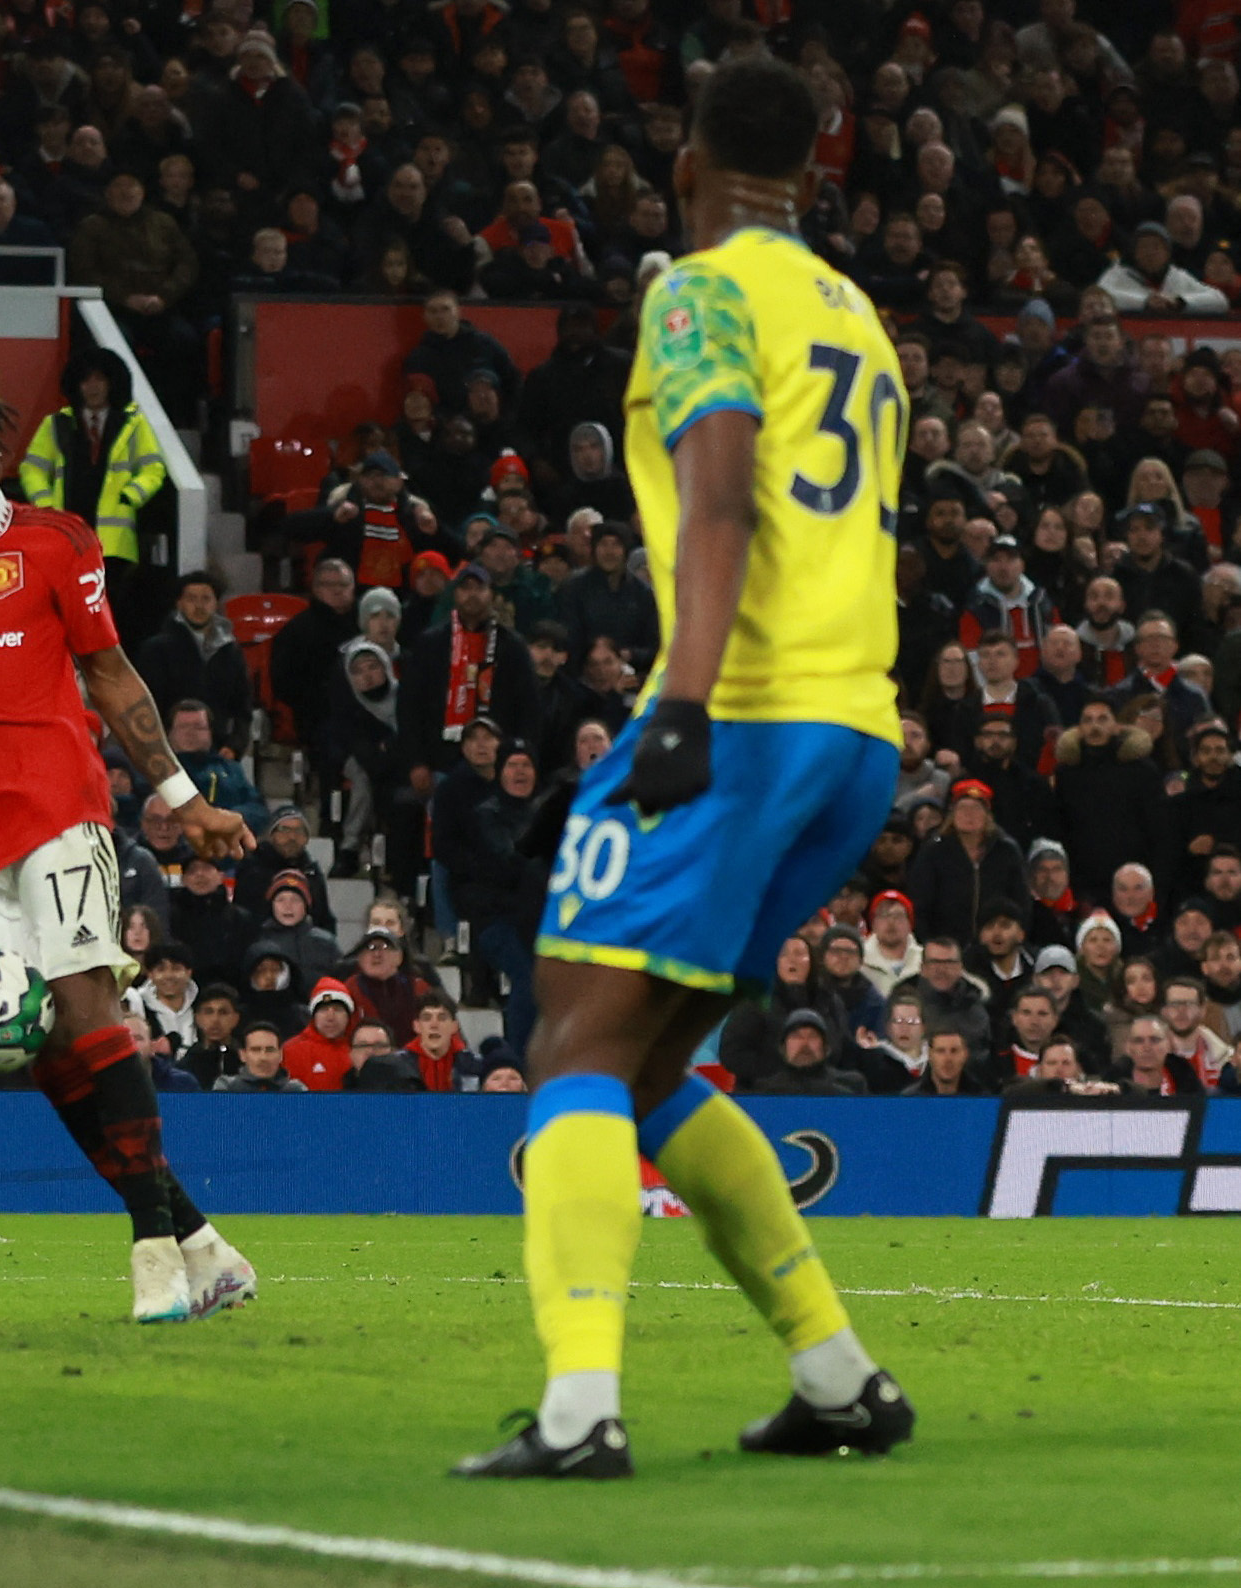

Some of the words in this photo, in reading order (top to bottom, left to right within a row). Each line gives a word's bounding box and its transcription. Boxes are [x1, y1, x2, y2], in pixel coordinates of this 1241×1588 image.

[789, 343, 908, 537] 30
[45, 865, 92, 925] 17
[547, 814, 630, 900] 30
